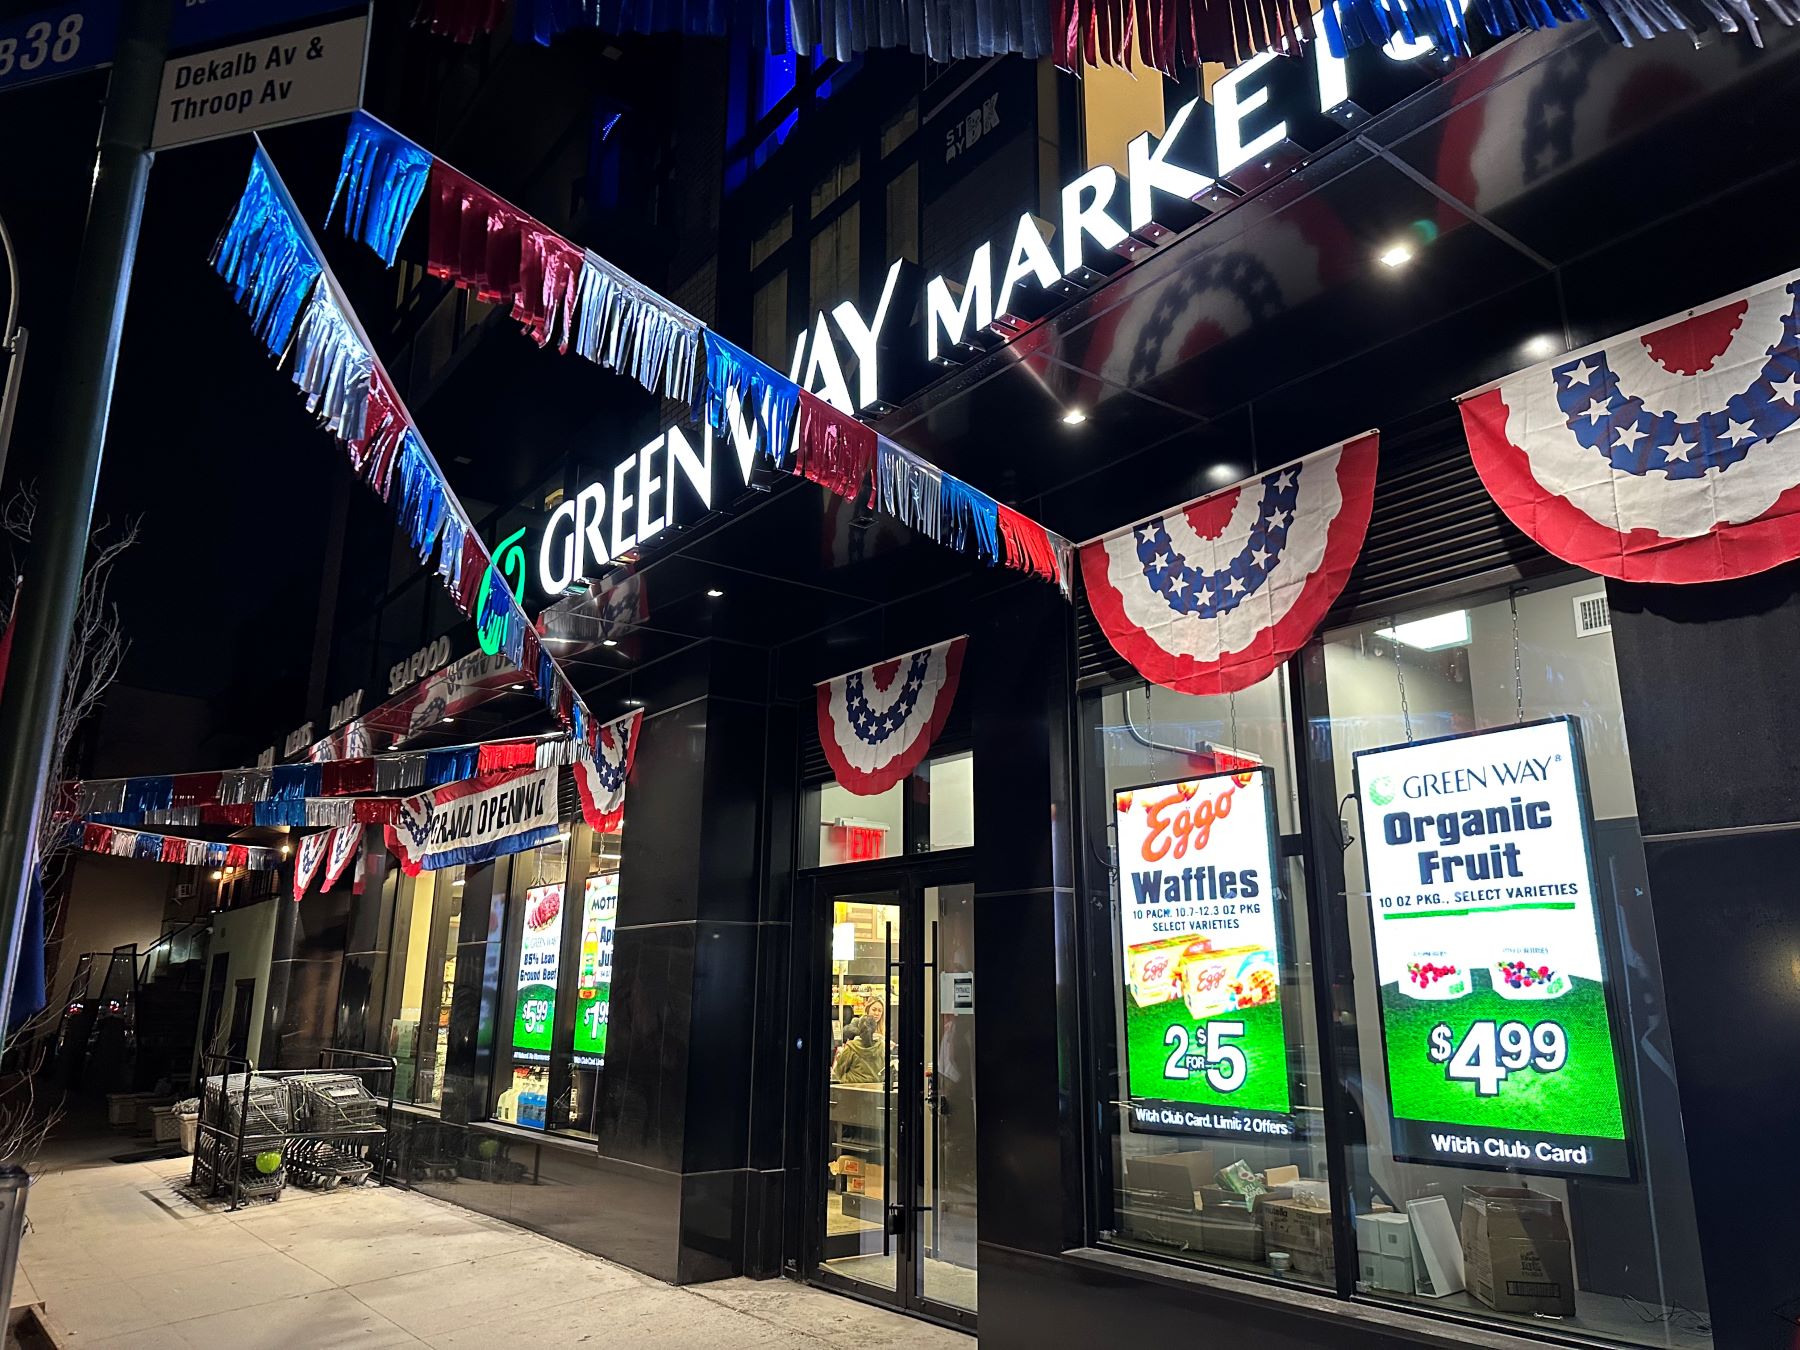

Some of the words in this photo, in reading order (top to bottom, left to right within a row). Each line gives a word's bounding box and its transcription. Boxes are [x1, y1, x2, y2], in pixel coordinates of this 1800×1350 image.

[174, 53, 256, 90] Dekalb
[264, 44, 298, 71] Av
[306, 36, 325, 60] &
[170, 88, 254, 123] Throop
[259, 80, 293, 105] Av
[539, 398, 713, 595] GREEN
[722, 256, 904, 488] WAY
[388, 635, 452, 696] SEAFOOD
[1403, 765, 1488, 799] GREEN
[1141, 786, 1236, 863] Eggo
[1383, 796, 1553, 847] Organic
[852, 827, 883, 860] EXIT
[1417, 842, 1524, 886] Fruit
[1130, 865, 1260, 905] Waffles
[1379, 897, 1393, 908] 10
[1396, 895, 1413, 907] OZ
[1454, 888, 1502, 903] SELECT
[1505, 883, 1579, 899] VARIETIES
[1133, 909, 1143, 920] 10
[1176, 906, 1219, 917] 10.7-12.3
[1223, 904, 1236, 915] OZ
[1240, 903, 1260, 914] PKG
[1152, 921, 1186, 932] SELECT
[1189, 919, 1240, 931] VARIETIES
[524, 952, 539, 966] 85%
[540, 952, 555, 965] Lean
[542, 967, 557, 981] Beef
[1142, 958, 1169, 983] Eggo
[1197, 968, 1227, 992] Eggo
[1164, 1024, 1190, 1079] 2
[1185, 1055, 1206, 1070] FOR
[1135, 1107, 1160, 1123] With
[1160, 1109, 1184, 1125] Club
[1213, 1116, 1242, 1131] Limit
[1243, 1117, 1252, 1132] 2
[1431, 1133, 1480, 1155] With
[1483, 1138, 1531, 1159] Club
[1535, 1141, 1588, 1165] Card
